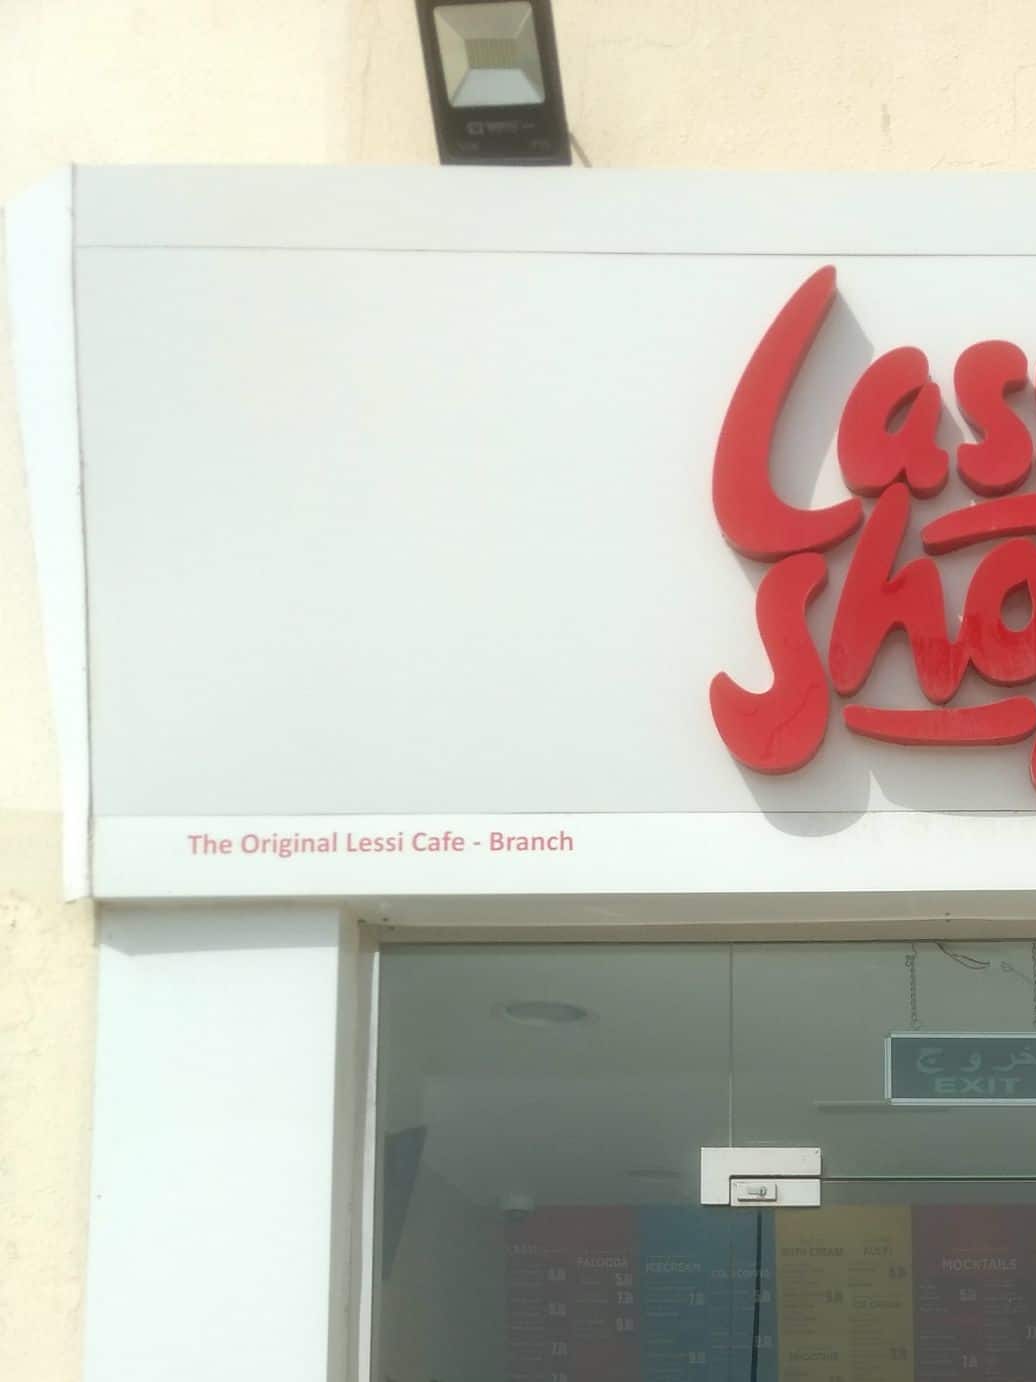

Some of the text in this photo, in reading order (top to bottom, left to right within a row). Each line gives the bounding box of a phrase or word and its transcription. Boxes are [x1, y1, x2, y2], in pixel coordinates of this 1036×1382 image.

[188, 833, 232, 855] The
[240, 831, 338, 859] Original
[346, 831, 403, 853] Lessi
[411, 830, 465, 853] Cafe
[488, 829, 574, 852] Branch
[934, 1077, 1022, 1094] EXIT
[940, 1256, 1018, 1272] MOCKTAILS
